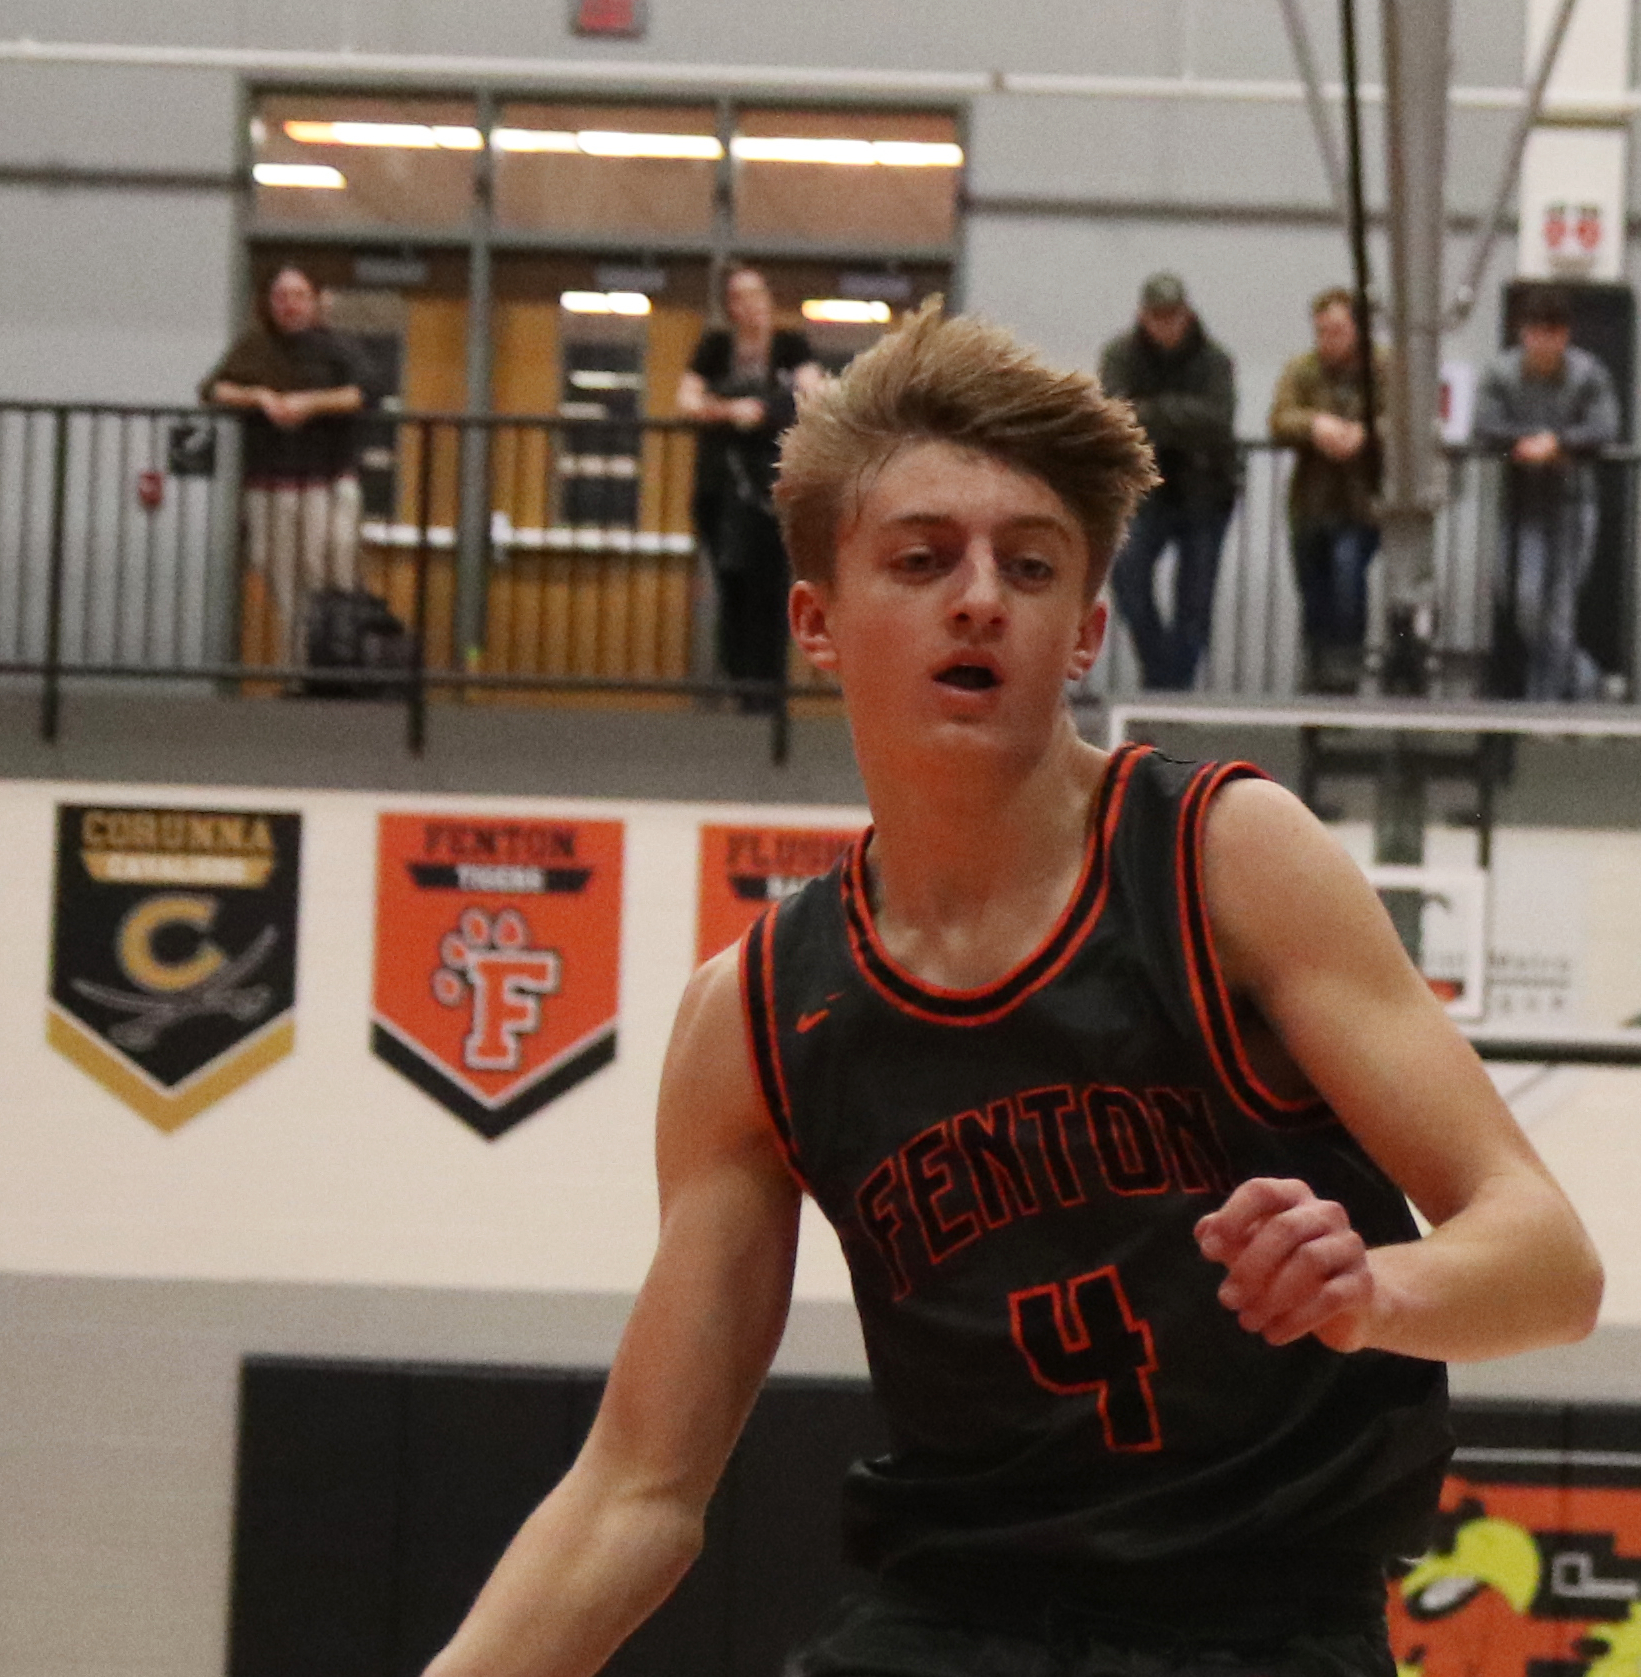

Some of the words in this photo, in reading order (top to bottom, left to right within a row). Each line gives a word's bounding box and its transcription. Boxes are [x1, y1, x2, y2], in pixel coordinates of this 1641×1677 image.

[423, 823, 575, 857] FENTON
[855, 1083, 1238, 1302] FENTON
[1007, 1263, 1163, 1453] 4
